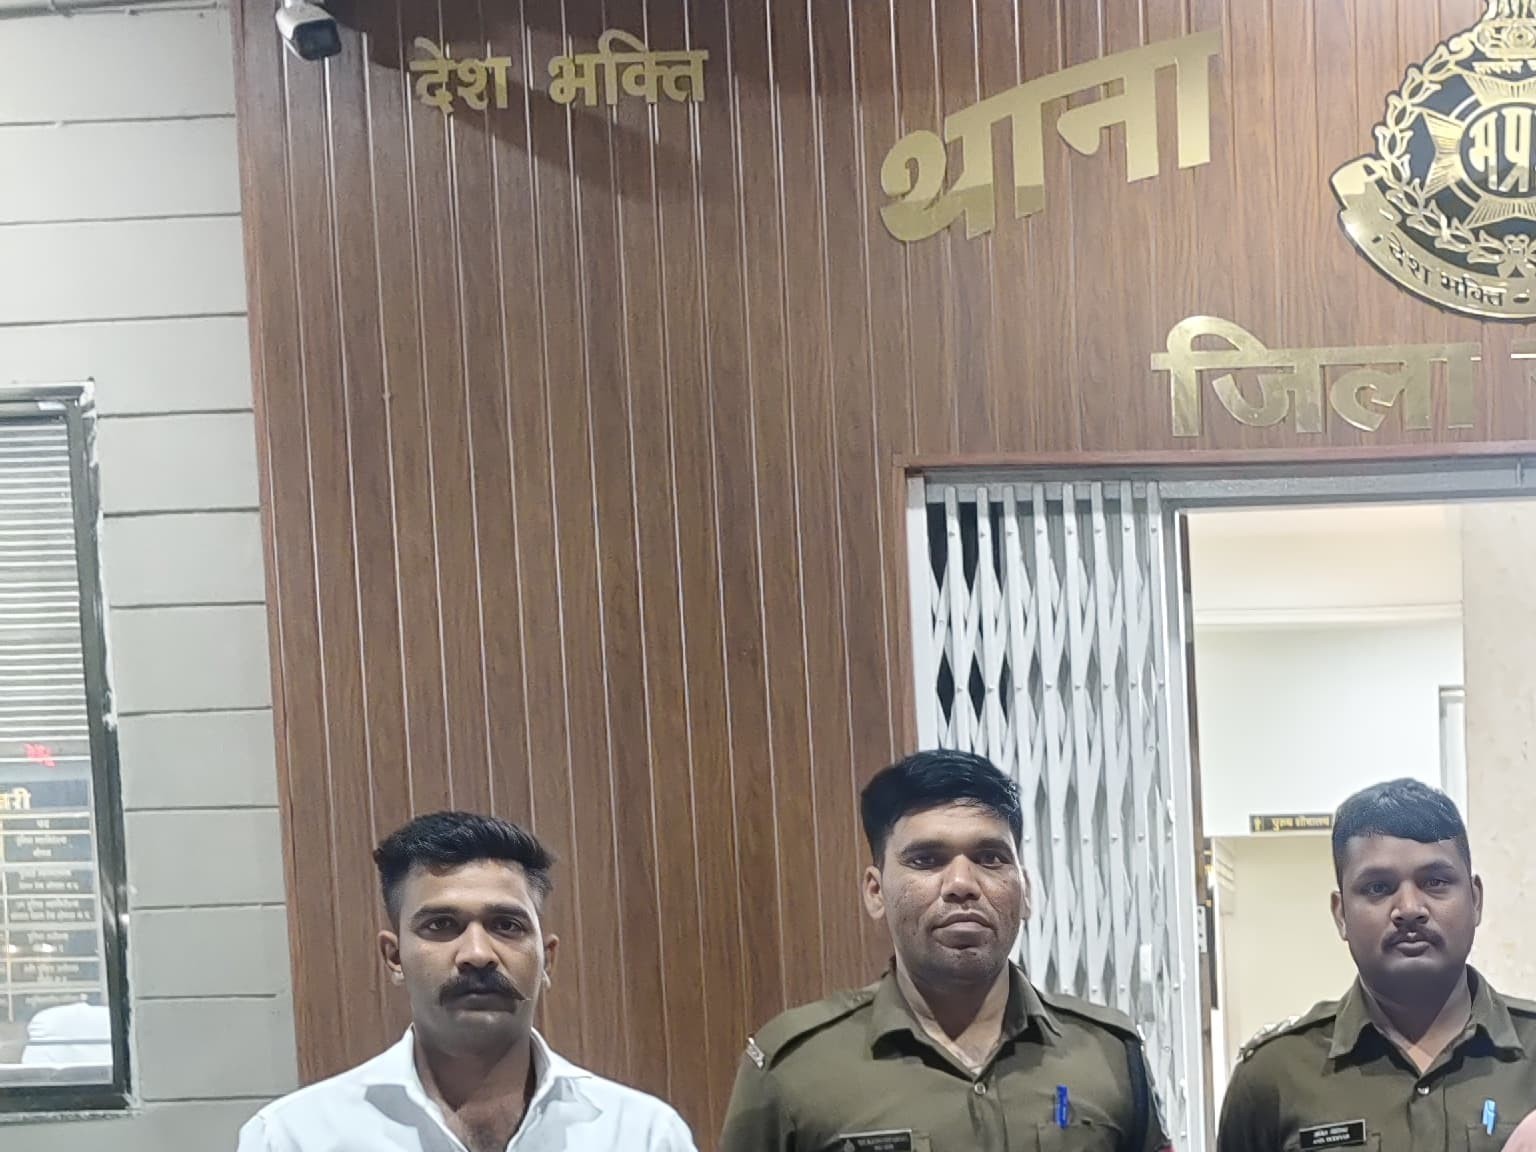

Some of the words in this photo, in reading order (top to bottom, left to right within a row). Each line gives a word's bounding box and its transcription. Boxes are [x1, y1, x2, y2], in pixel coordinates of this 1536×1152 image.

[409, 37, 511, 113] देश
[548, 29, 709, 106] भक्ति
[880, 30, 1222, 241] थाना
[1150, 315, 1482, 437] जिला
